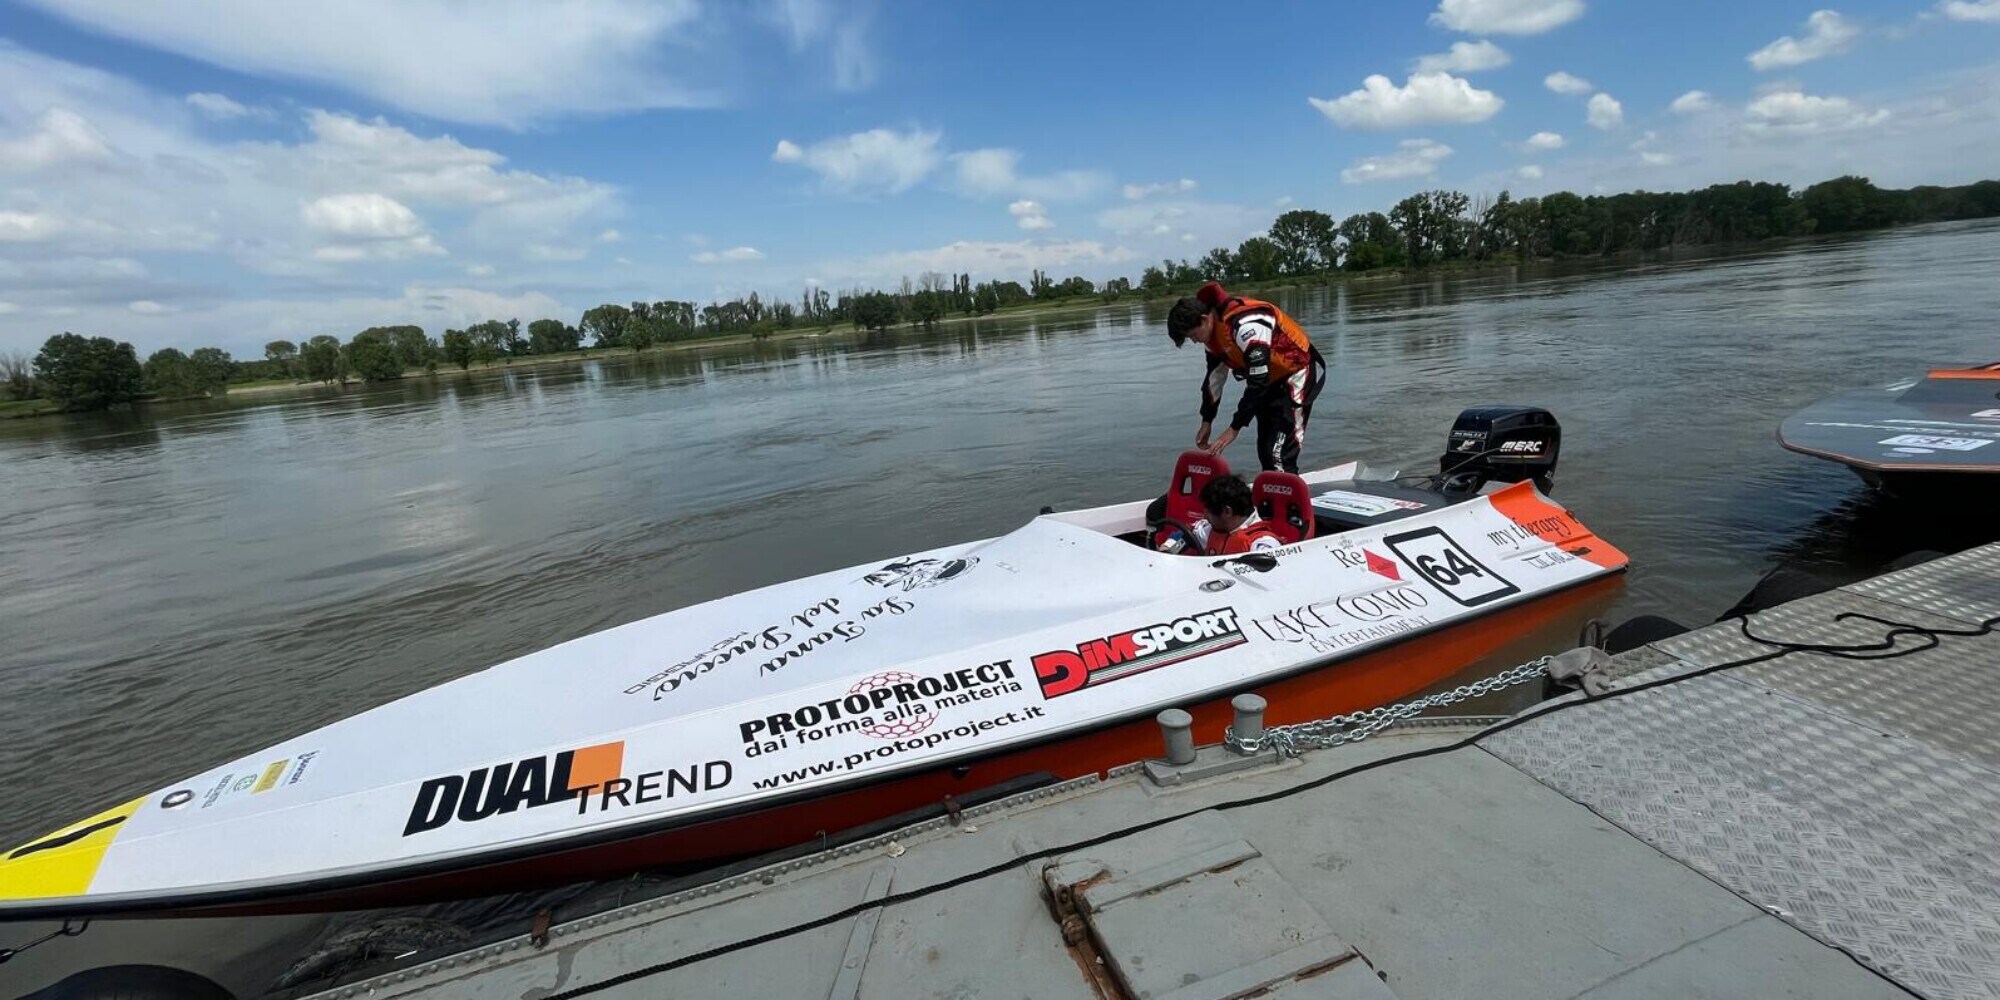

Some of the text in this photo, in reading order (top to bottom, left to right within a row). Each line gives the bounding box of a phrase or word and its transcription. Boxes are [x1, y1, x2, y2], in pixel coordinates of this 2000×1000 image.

[1500, 441, 1543, 453] MERC
[1487, 529, 1520, 550] my
[1512, 517, 1572, 540] therapy
[1330, 549, 1366, 568] Re
[1416, 547, 1484, 587] 64
[1252, 585, 1429, 643] LAKE COMO
[1310, 614, 1432, 654] ENTERTAINMENT
[739, 659, 1016, 744] PROTOPROJECT
[744, 680, 1023, 758] dai forma alla materia
[752, 704, 1046, 789] www.protoproject.it
[402, 749, 580, 838] DUAL
[573, 760, 733, 815] TREND
